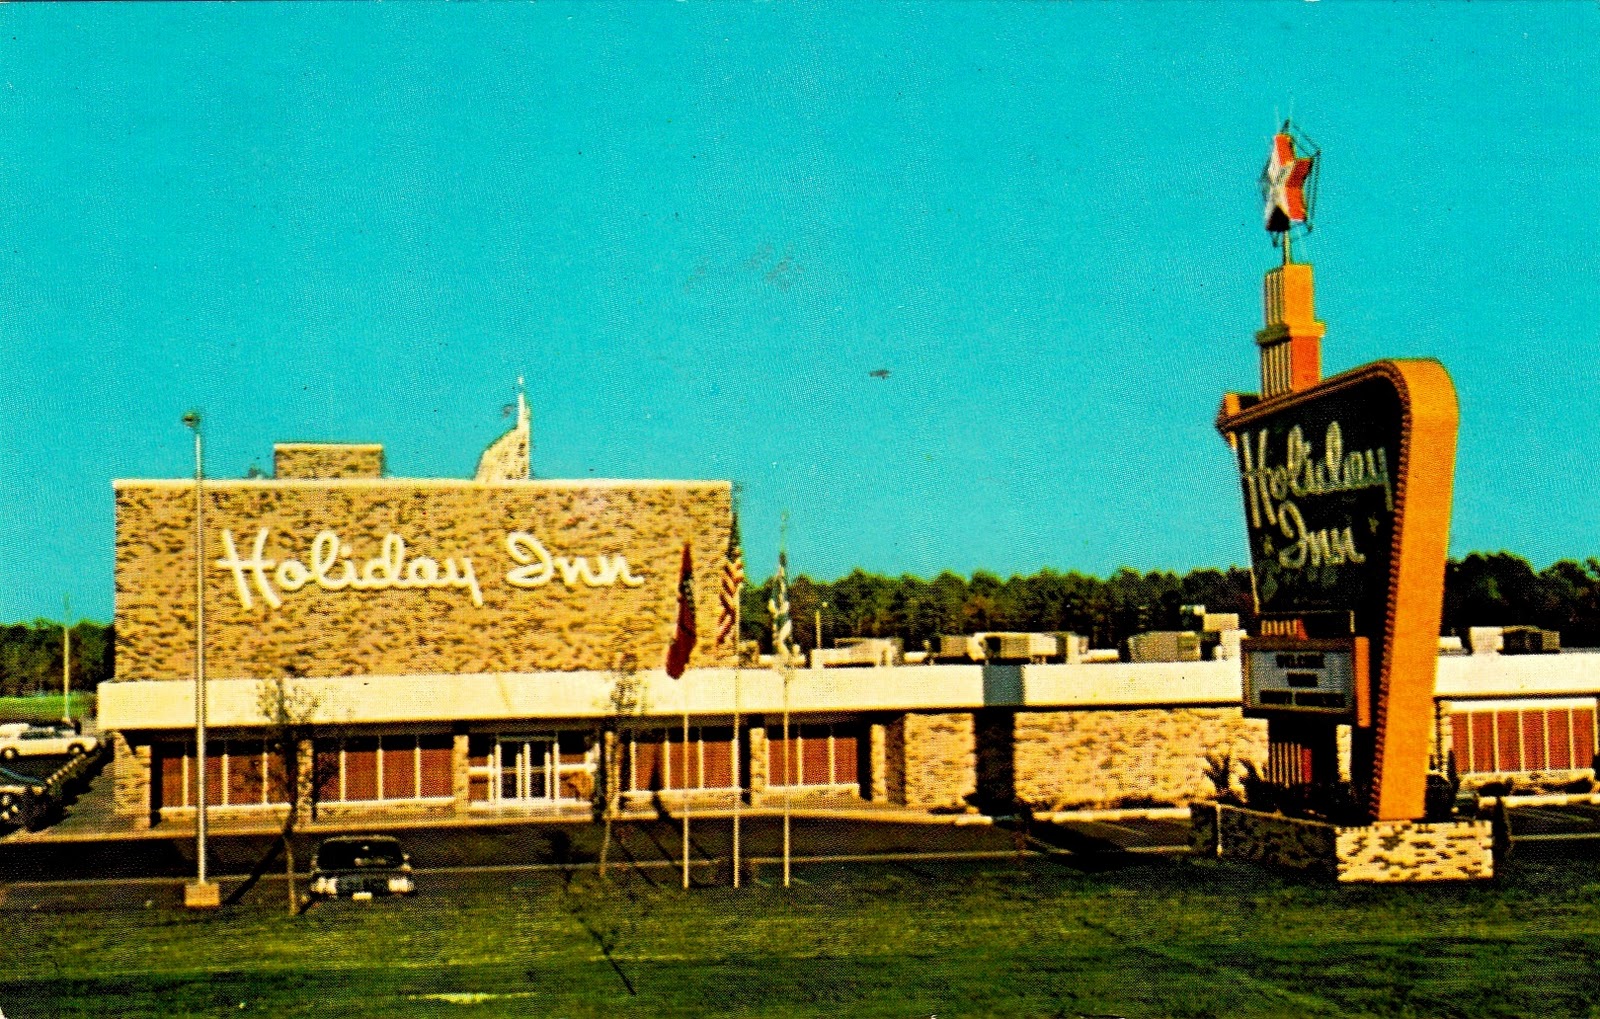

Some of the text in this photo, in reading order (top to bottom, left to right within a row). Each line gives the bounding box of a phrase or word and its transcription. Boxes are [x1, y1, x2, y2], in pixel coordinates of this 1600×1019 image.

[1242, 421, 1394, 528] Holiday
[216, 527, 645, 608] Holiday Inn
[1278, 501, 1366, 568] Inn
